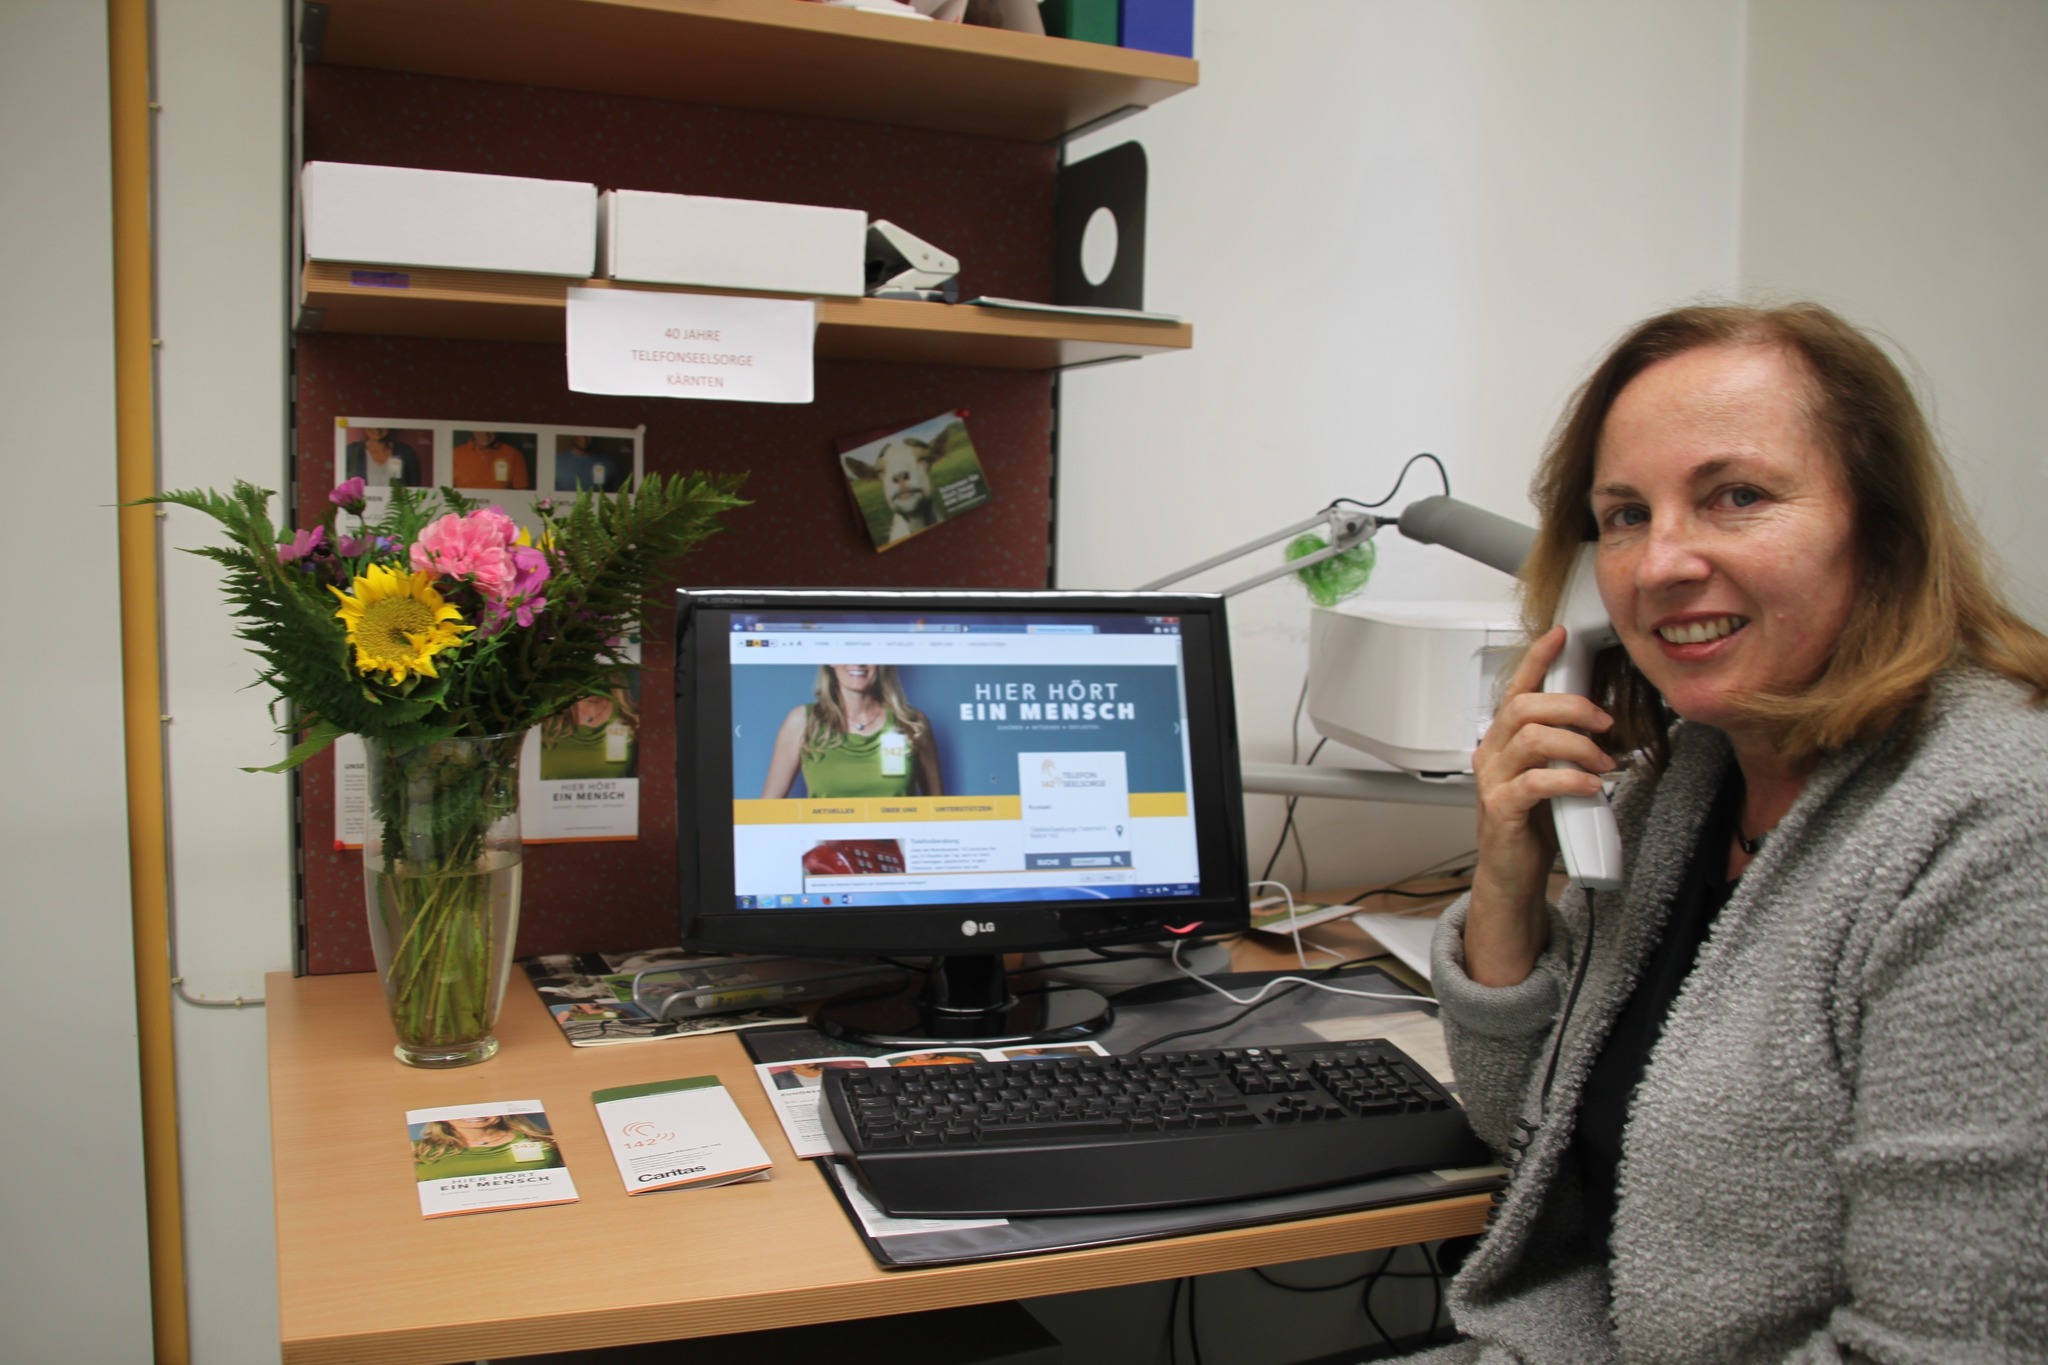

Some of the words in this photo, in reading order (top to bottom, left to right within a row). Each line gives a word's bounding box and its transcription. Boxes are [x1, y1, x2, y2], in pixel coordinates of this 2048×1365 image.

[664, 327, 681, 340] 40
[682, 329, 721, 342] JAHRE
[631, 349, 754, 367] TELEFONSEELSORGE
[666, 373, 724, 388] KÄRNTEN
[975, 683, 1036, 701] HIER
[1048, 679, 1119, 701] HÖRT
[960, 703, 1007, 721] EIN
[1019, 702, 1136, 721] MENSCH
[561, 783, 585, 791] HIER
[588, 781, 617, 791] HÖRT
[553, 793, 572, 801] EIN
[576, 791, 625, 801] MENSCH
[812, 807, 855, 815] AKTUELLES
[978, 921, 996, 933] LG
[624, 1138, 658, 1150] 142
[452, 1176, 487, 1185] HIER
[637, 1164, 707, 1183] Caritas
[440, 1183, 469, 1192] EIN
[476, 1176, 551, 1188] MENSCH
